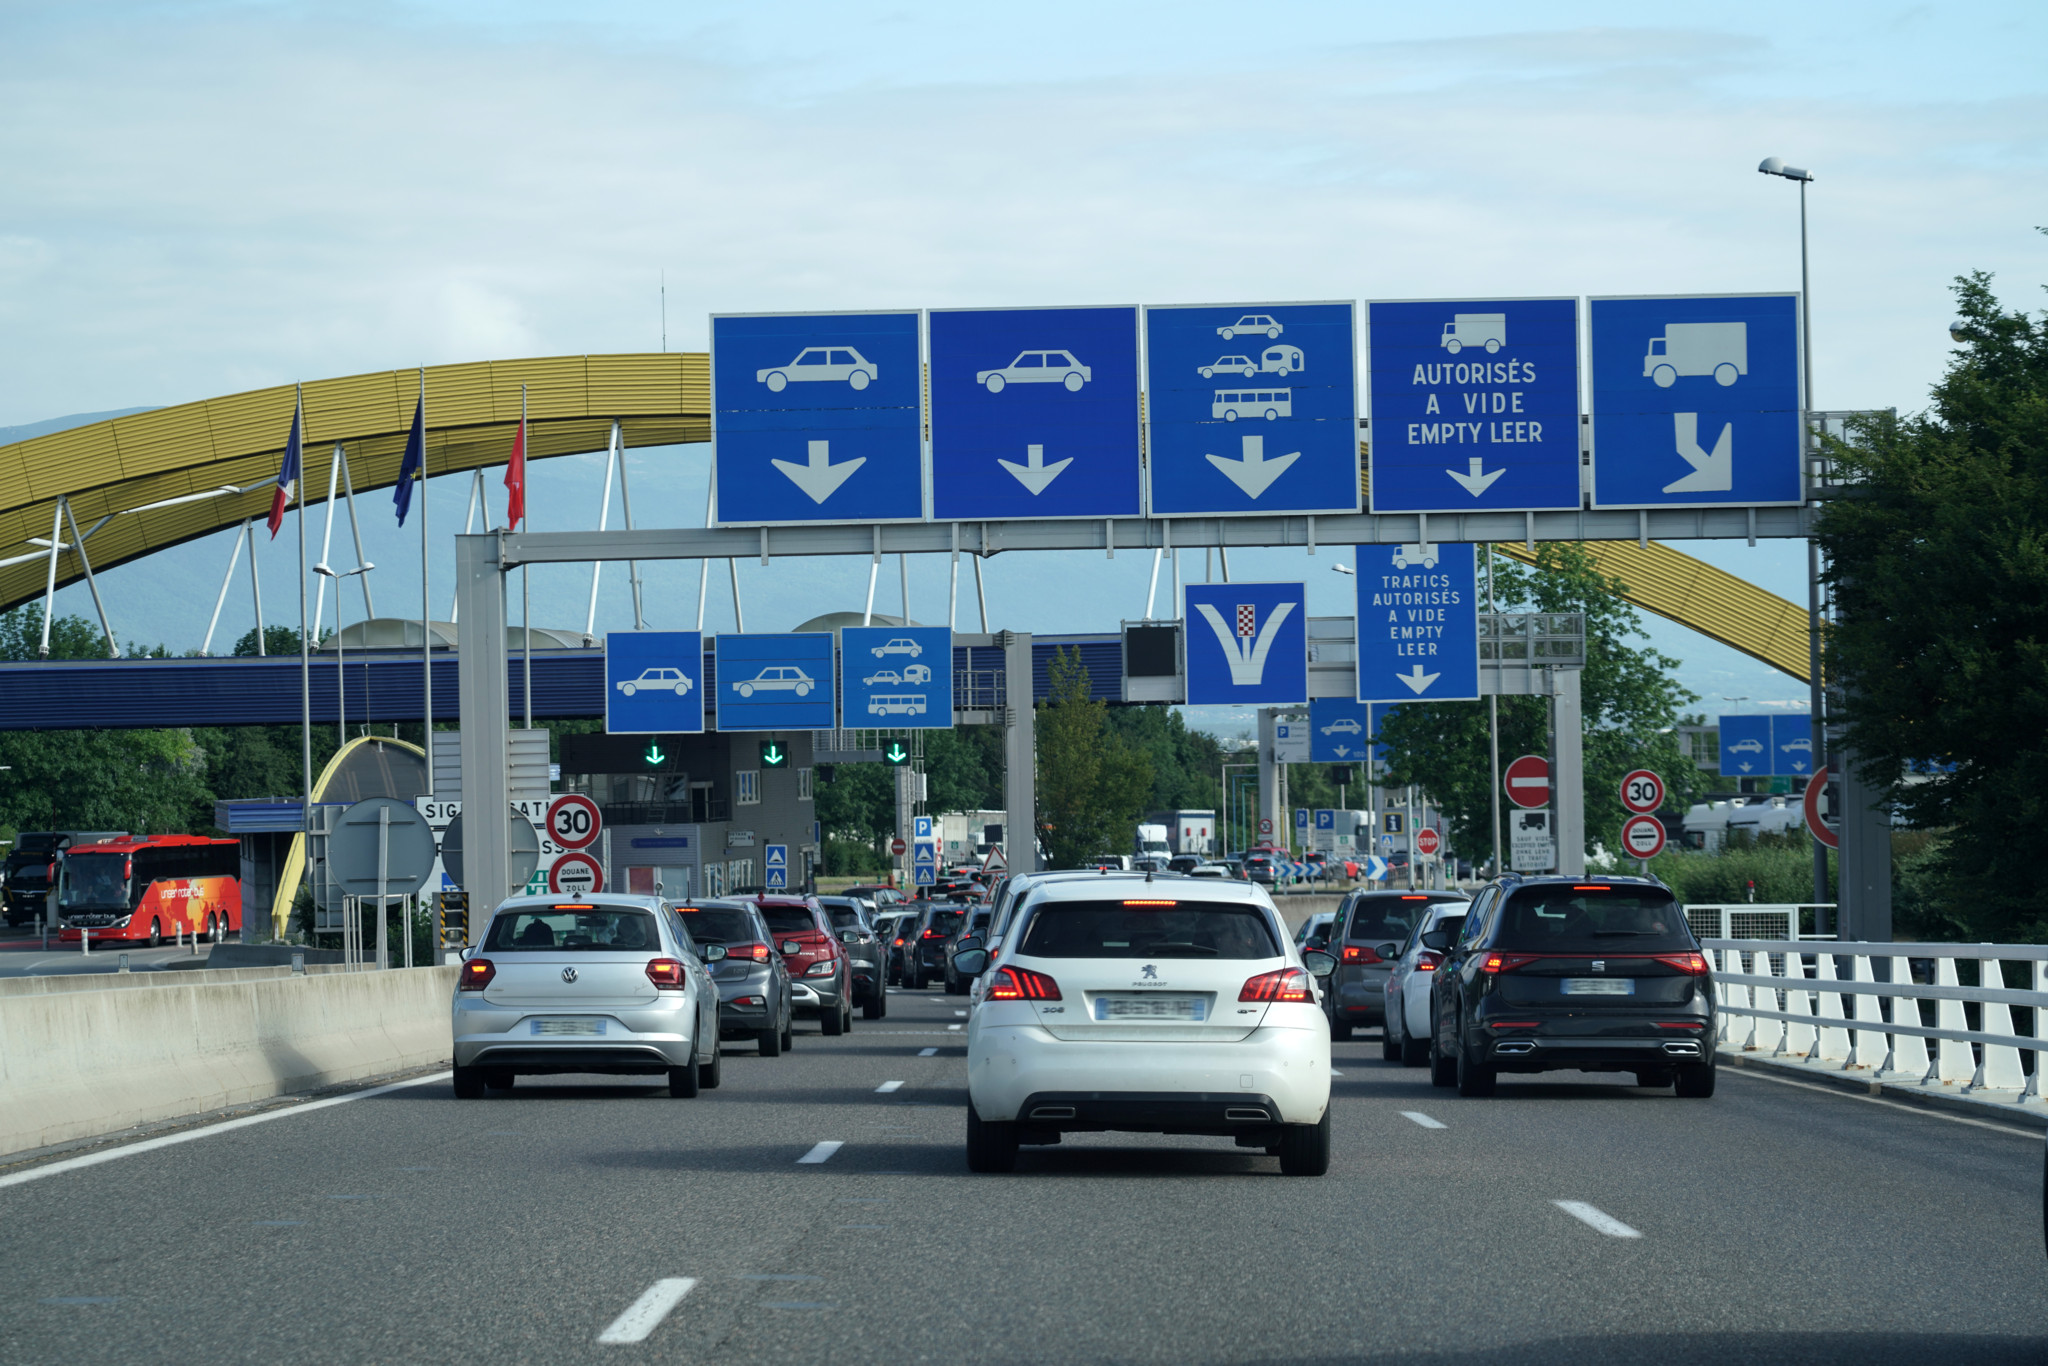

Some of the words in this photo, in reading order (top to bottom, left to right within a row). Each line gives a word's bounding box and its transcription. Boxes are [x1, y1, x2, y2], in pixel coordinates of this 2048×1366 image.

[1413, 358, 1536, 385] AUTORISÉS
[1426, 394, 1440, 414] A
[1464, 392, 1524, 414] VIDE
[1408, 422, 1482, 444] EMPTY
[1490, 421, 1543, 443] LEER
[1382, 574, 1450, 589] TRAFICS
[1373, 589, 1460, 606] AUTORISÉS
[1389, 610, 1397, 622] A
[1408, 609, 1445, 622] VIDE
[1390, 626, 1443, 640] EMPTY
[1397, 642, 1438, 656] LEER
[1630, 782, 1656, 802] 30
[426, 804, 462, 818] SIG
[557, 810, 590, 834] 30
[1419, 837, 1437, 847] STOP
[562, 868, 589, 876] DOUANE
